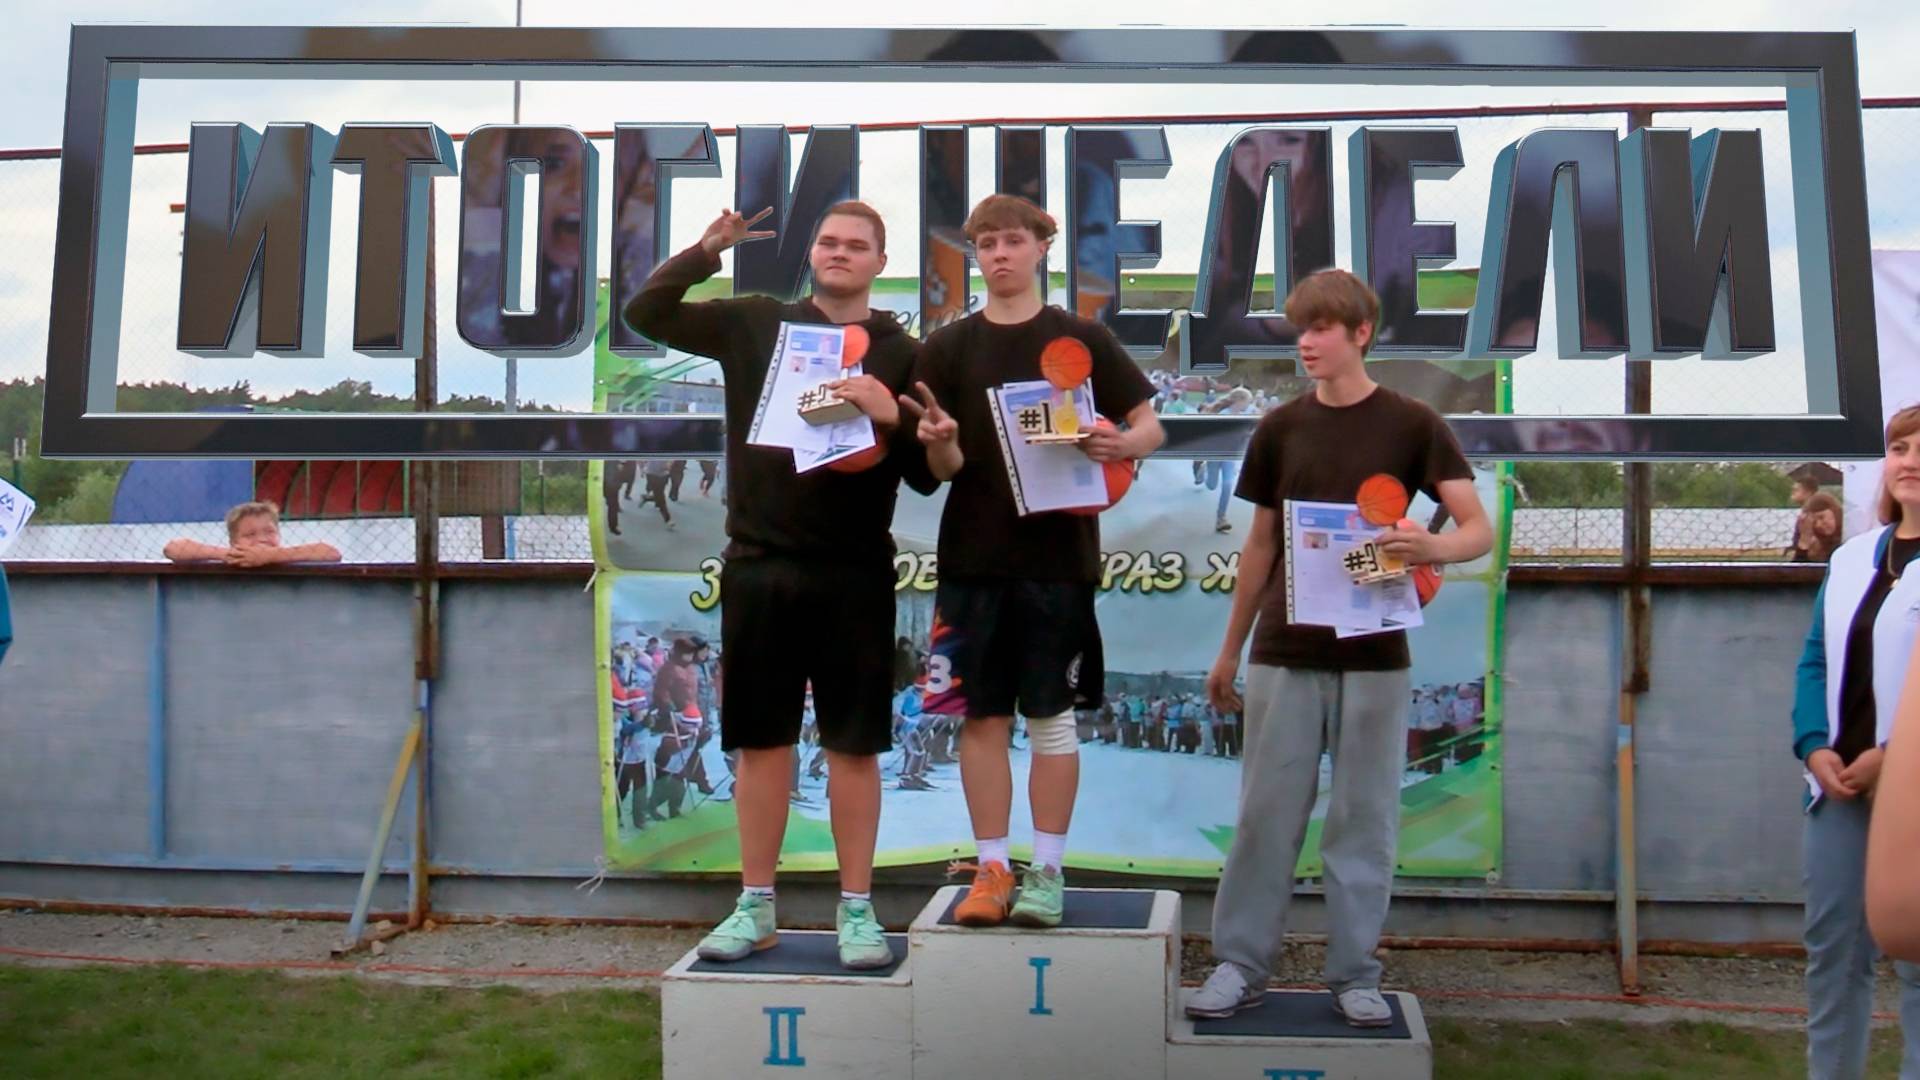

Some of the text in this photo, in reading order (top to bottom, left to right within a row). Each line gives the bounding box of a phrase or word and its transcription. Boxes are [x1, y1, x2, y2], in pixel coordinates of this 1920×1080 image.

[1019, 402, 1053, 434] #1
[1100, 550, 1186, 595] РАЗ
[1028, 957, 1053, 1016] I
[762, 1006, 807, 1067] II
